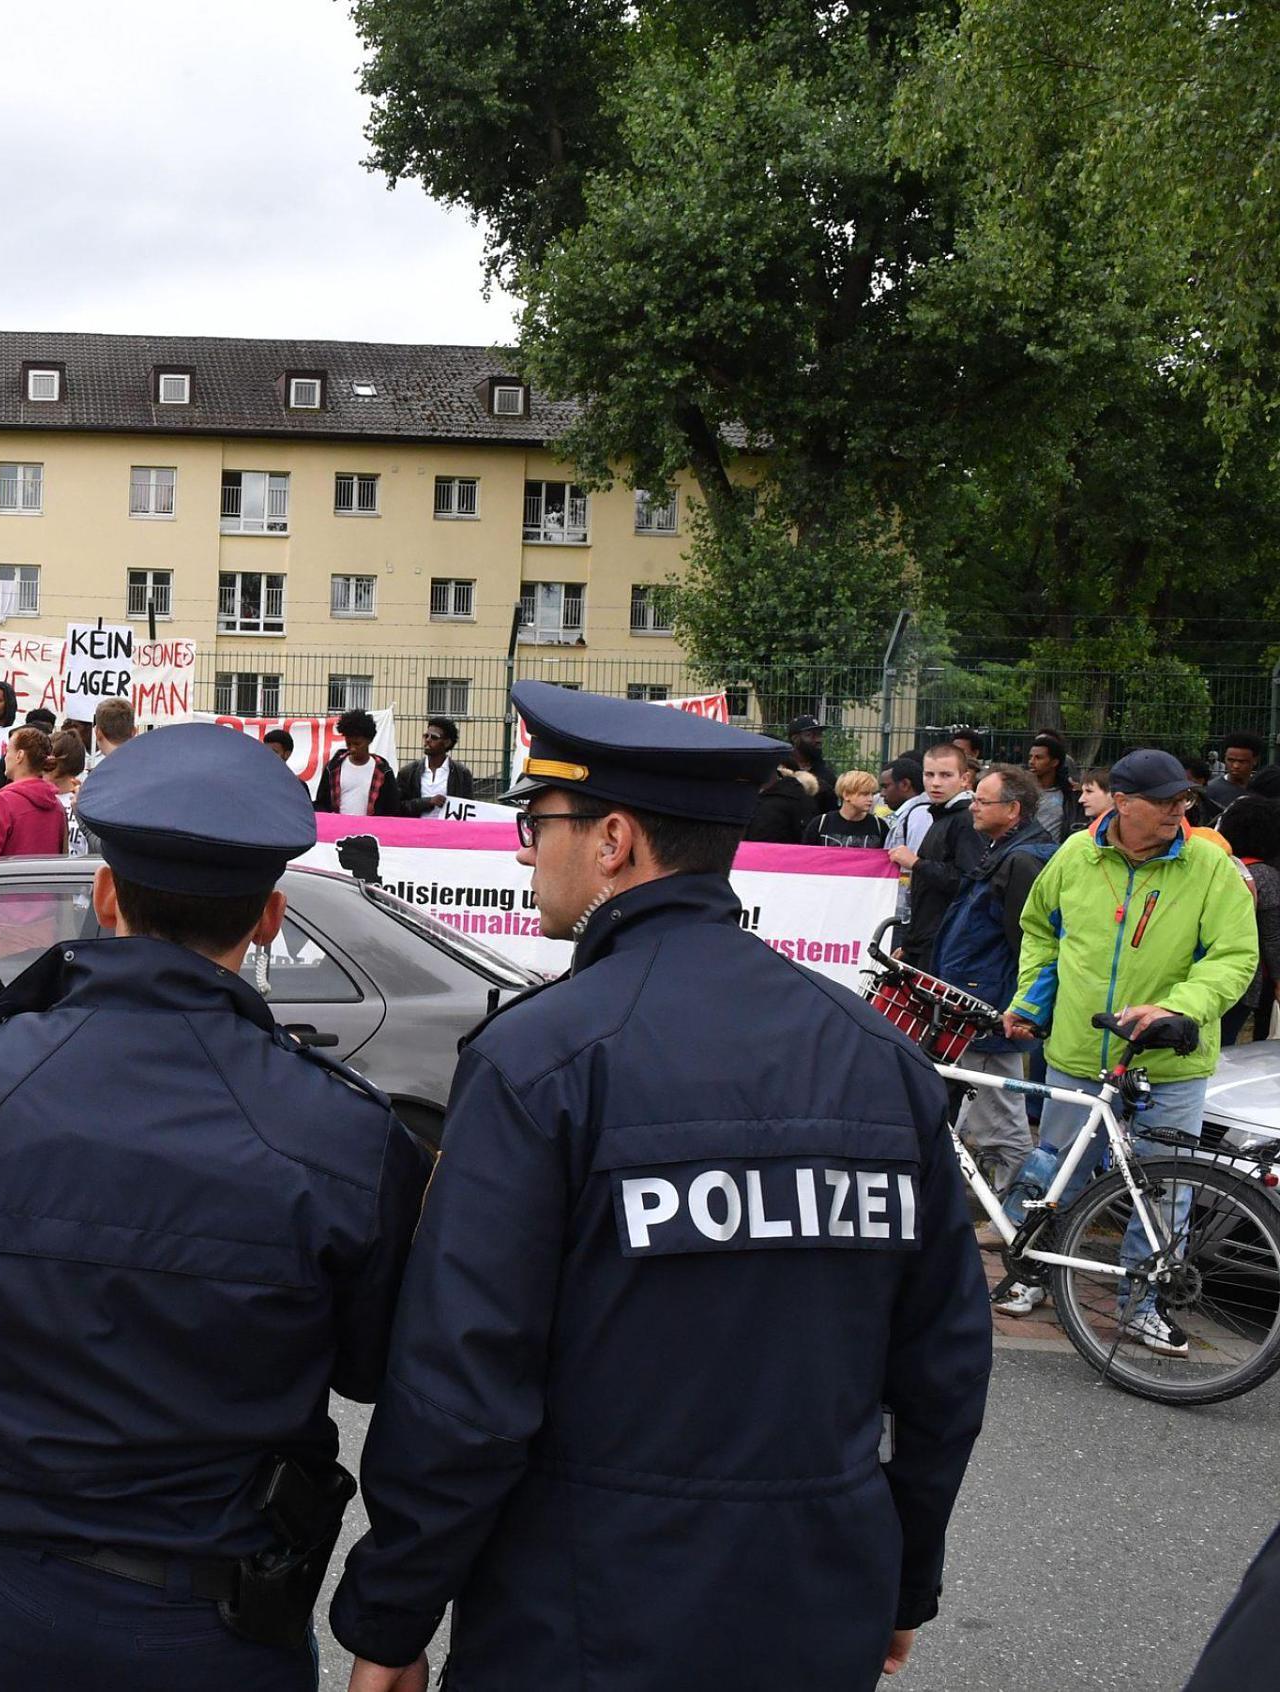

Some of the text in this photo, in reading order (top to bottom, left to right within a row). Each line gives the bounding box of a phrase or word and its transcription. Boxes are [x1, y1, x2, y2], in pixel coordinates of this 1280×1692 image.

[11, 640, 53, 662] ARE
[71, 629, 132, 660] KEIN
[66, 670, 131, 696] LAGER
[383, 881, 515, 911] alisierung
[621, 1167, 916, 1248] POLIZEI
